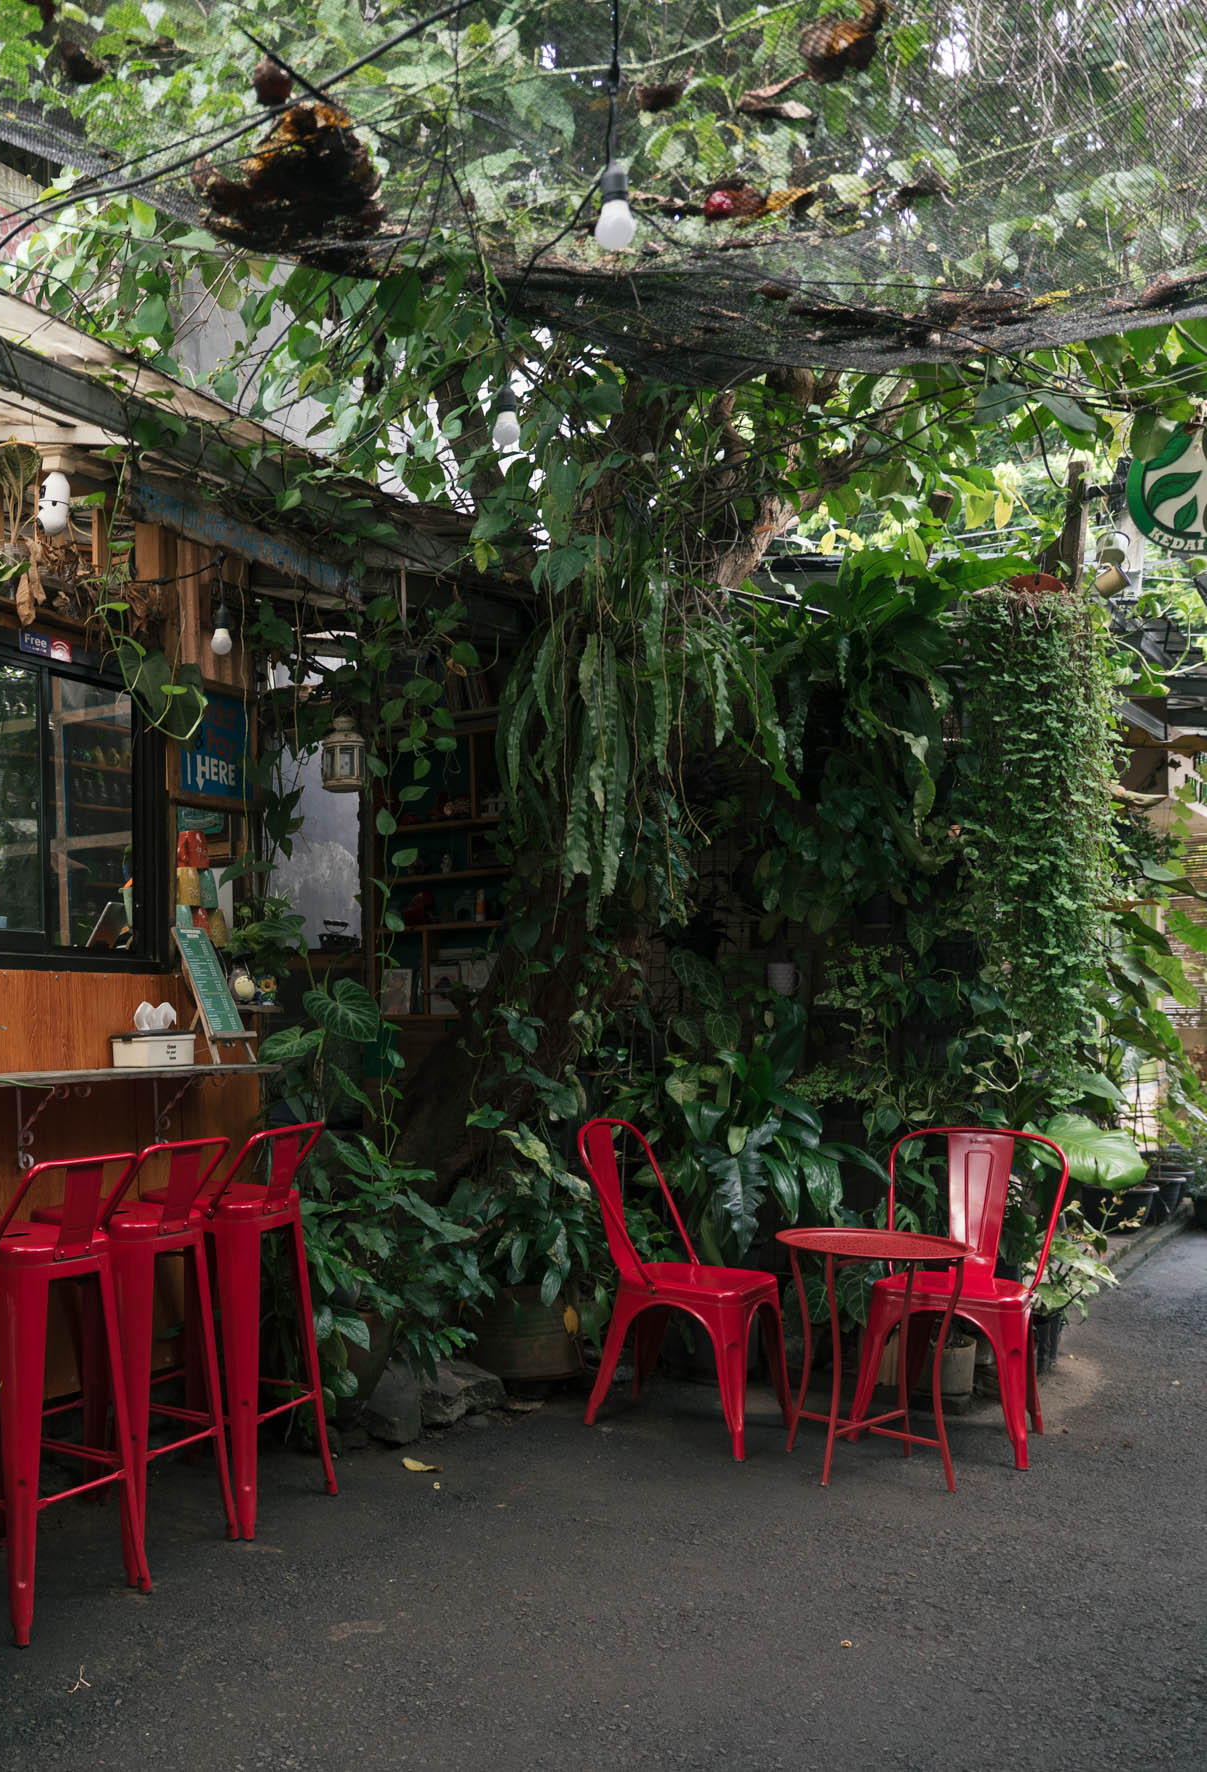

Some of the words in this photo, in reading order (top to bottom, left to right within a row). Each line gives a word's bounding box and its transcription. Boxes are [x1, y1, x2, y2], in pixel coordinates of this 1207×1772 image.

[1147, 526, 1206, 551] KEDAI
[24, 632, 48, 648] Free
[202, 696, 239, 728] rder
[196, 754, 237, 787] HERE
